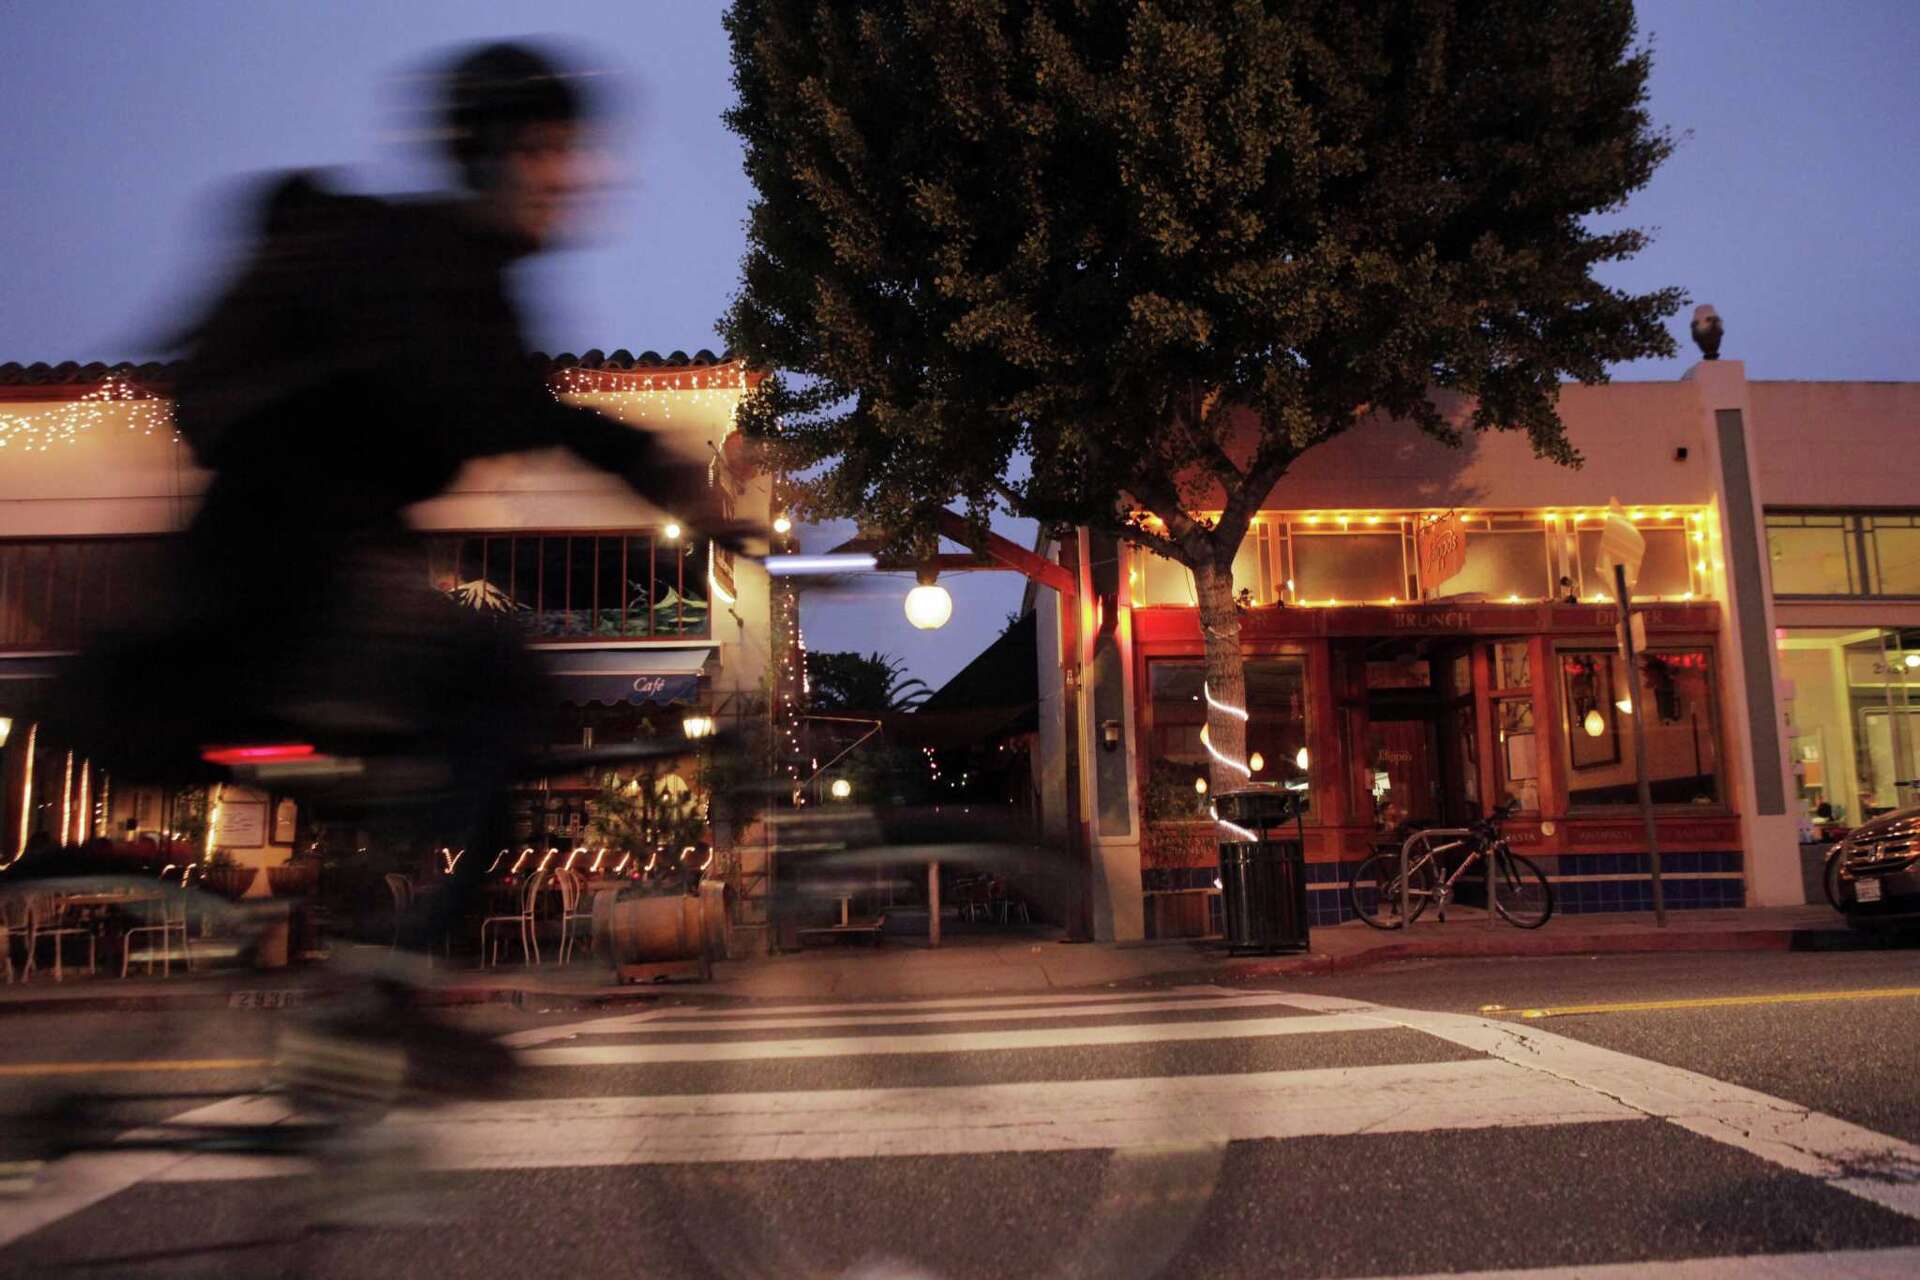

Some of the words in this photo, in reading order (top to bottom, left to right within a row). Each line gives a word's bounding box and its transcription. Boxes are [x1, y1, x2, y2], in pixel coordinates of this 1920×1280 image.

[1395, 612, 1471, 628] BRUNCH
[1596, 611, 1663, 625] DIER
[633, 677, 665, 696] Café
